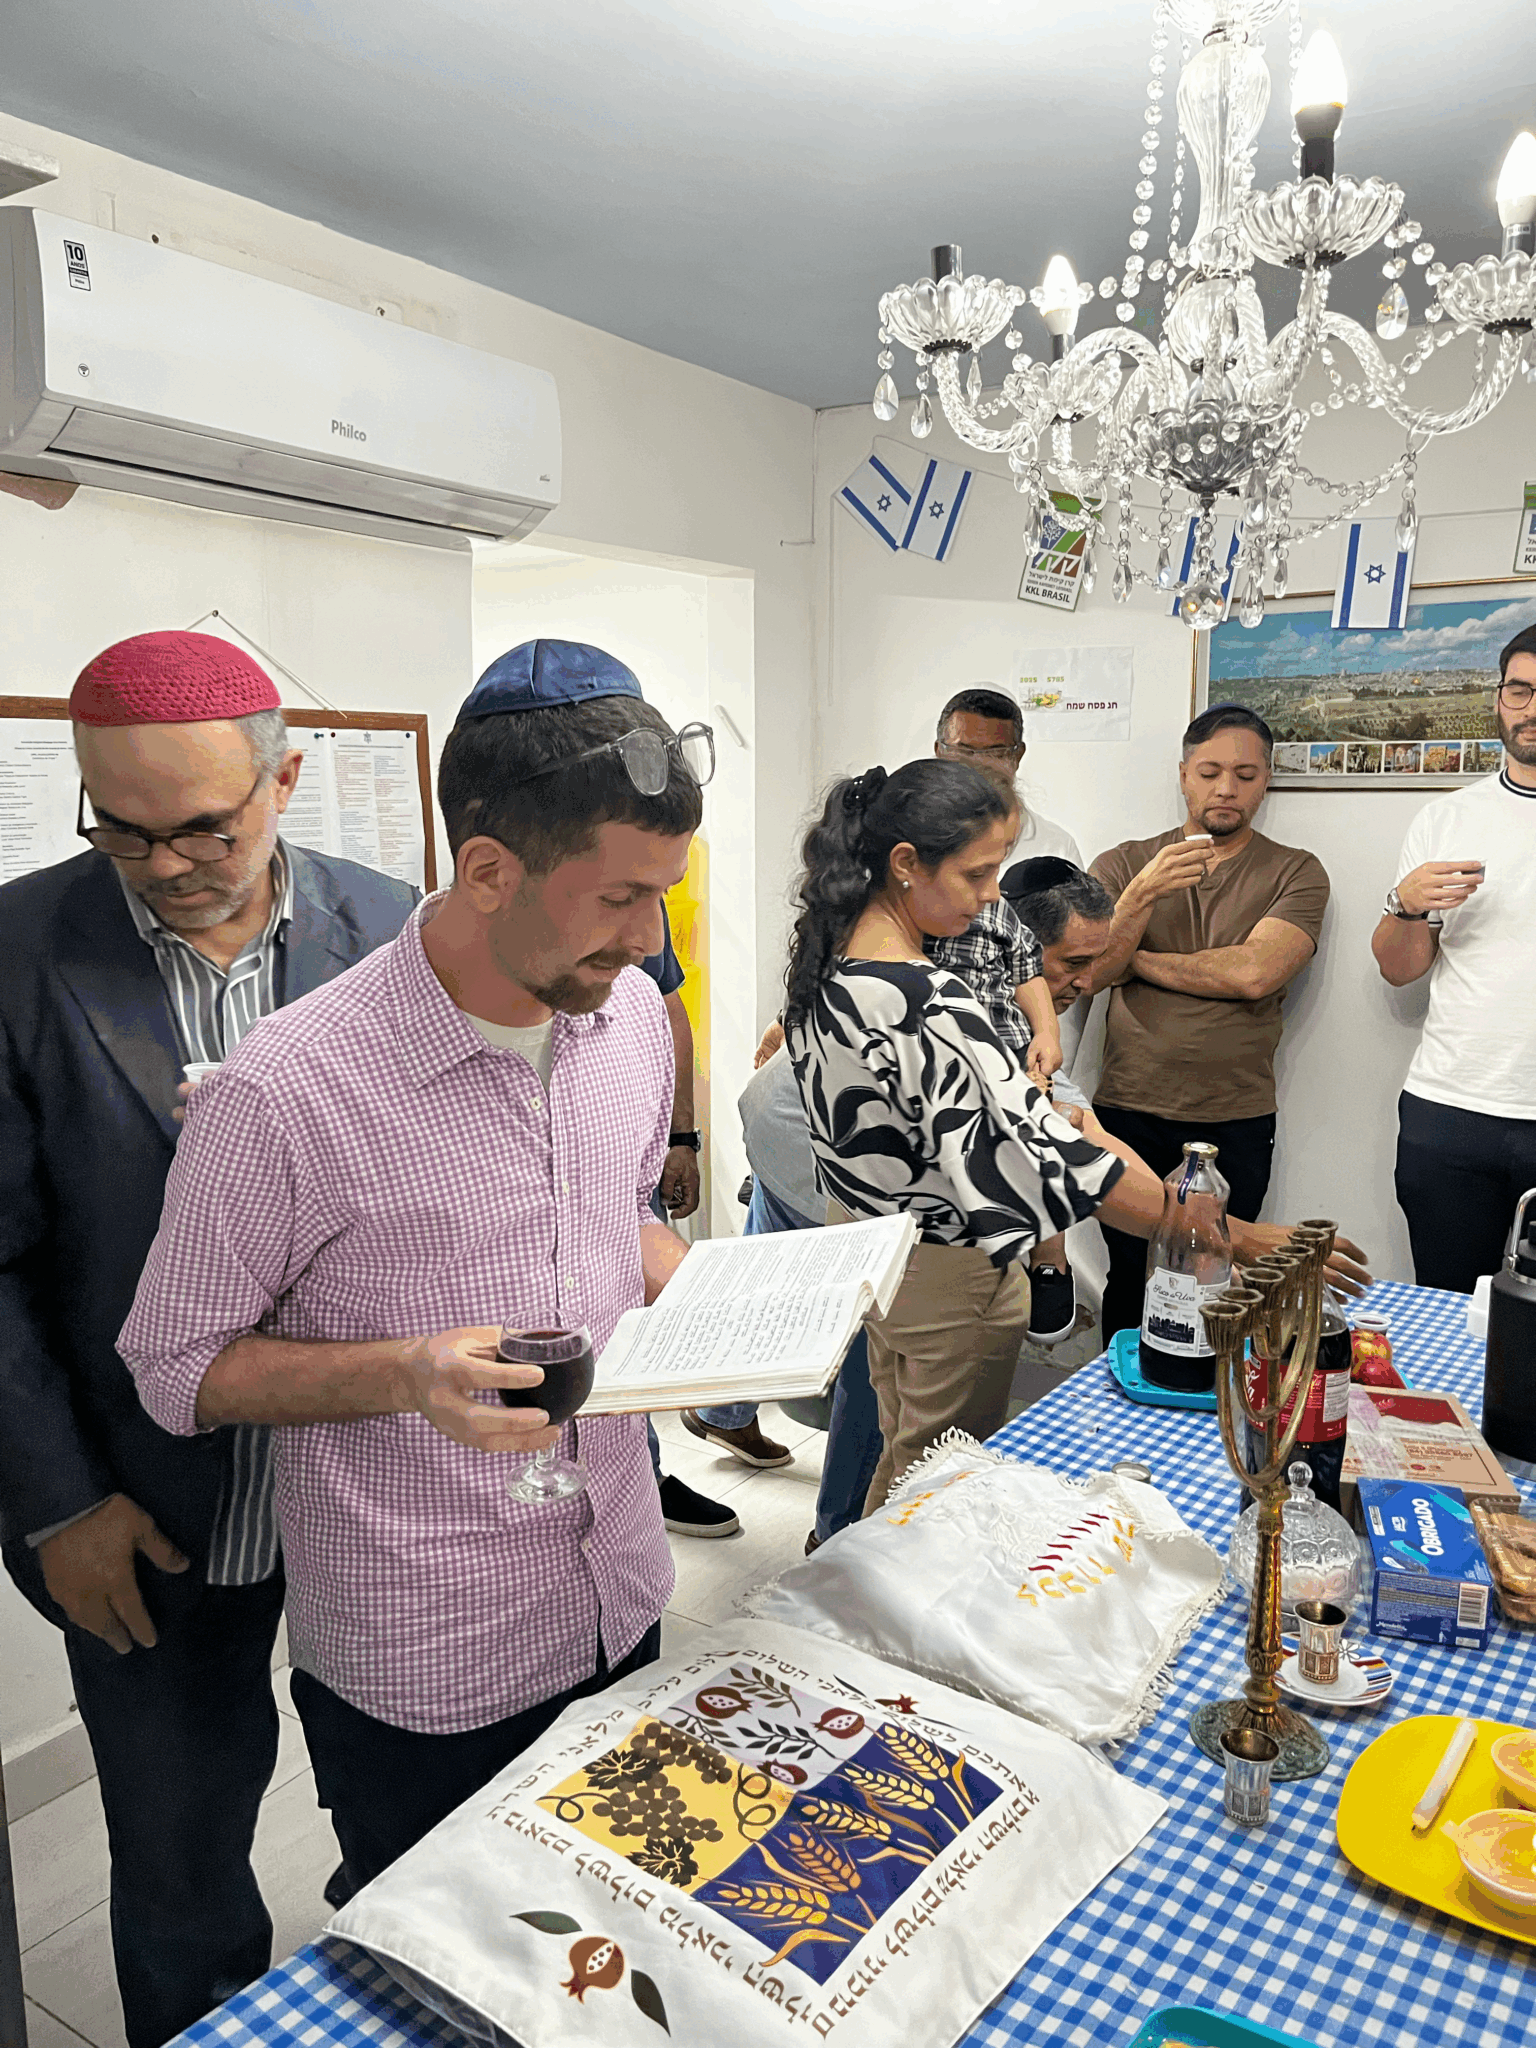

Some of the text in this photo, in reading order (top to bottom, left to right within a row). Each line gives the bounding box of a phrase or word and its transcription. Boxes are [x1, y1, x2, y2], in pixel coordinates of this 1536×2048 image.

[67, 244, 84, 262] 10
[331, 419, 367, 442] Philco
[1025, 585, 1070, 603] KKL BRASIL
[1066, 702, 1086, 710] שמח
[1087, 702, 1106, 710] פסח
[1174, 1291, 1196, 1302] Uva
[1411, 1498, 1445, 1556] OBRIGADO
[741, 1649, 810, 1682] השלום
[816, 1677, 877, 1711] מלאכי
[557, 1709, 625, 1757] מלאכי
[485, 1762, 555, 1820] השרת
[828, 1797, 1032, 2018] ברכוני לשלום מלאכי השלום
[503, 1810, 836, 2040] בואכם לשלום מלאכי השלום
